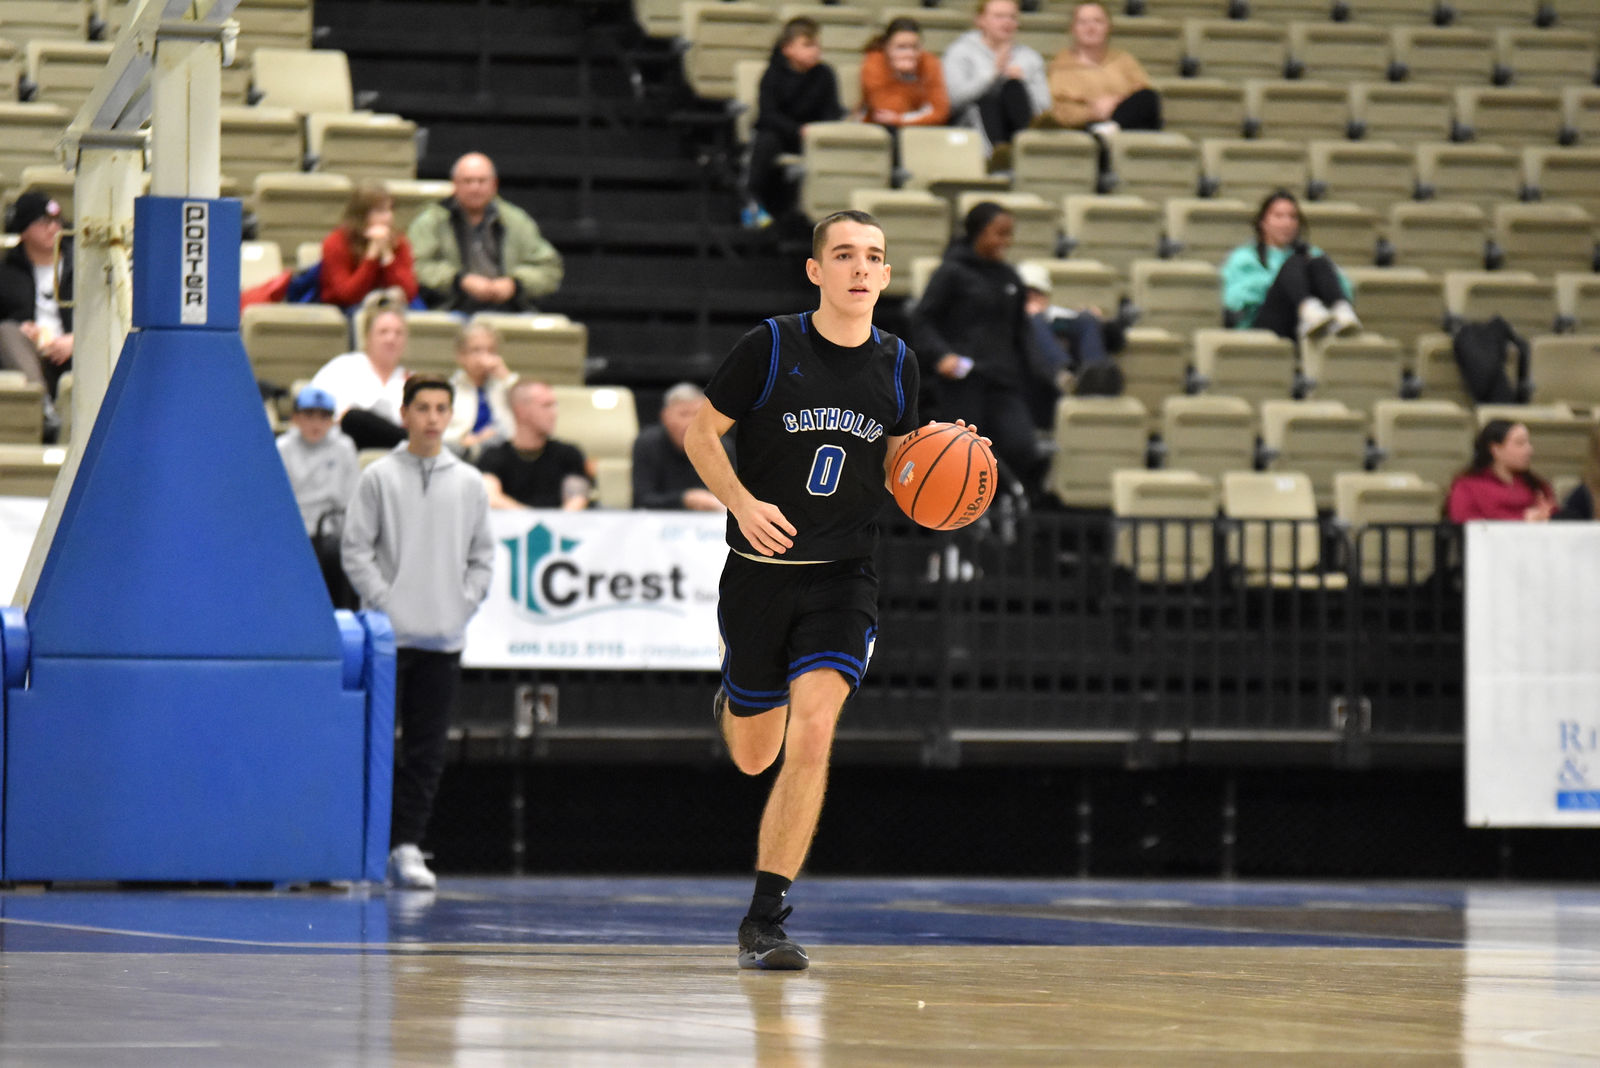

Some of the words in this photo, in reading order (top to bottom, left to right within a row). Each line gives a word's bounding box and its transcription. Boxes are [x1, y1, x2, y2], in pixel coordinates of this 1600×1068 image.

[185, 206, 205, 306] PORTER
[783, 408, 883, 443] CATHOLIC
[806, 444, 847, 497] 0
[949, 470, 988, 528] Wilson
[541, 560, 685, 607] Crest
